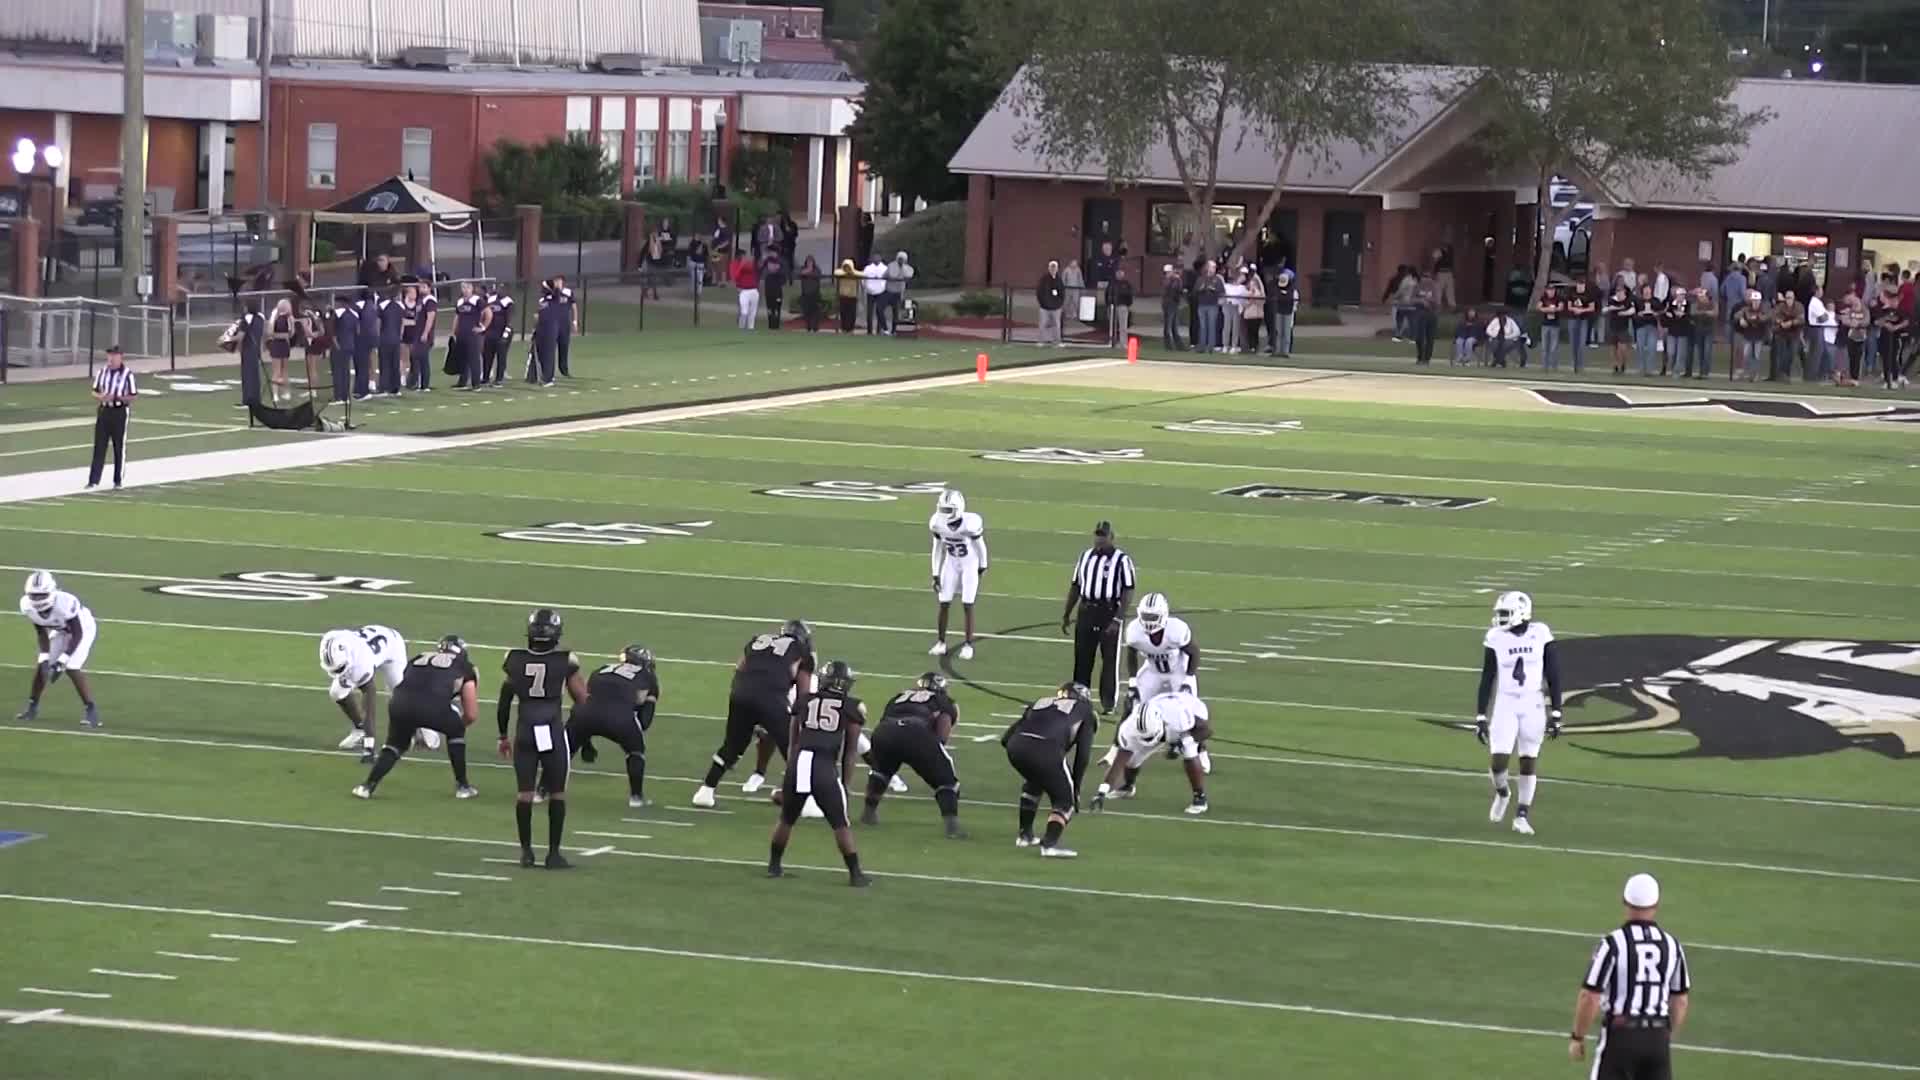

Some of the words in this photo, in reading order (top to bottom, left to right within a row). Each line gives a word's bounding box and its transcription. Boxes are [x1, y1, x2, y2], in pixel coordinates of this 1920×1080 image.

[945, 542, 968, 558] 23
[153, 571, 413, 600] 50
[524, 663, 546, 698] 7
[1512, 656, 1526, 687] 4
[804, 697, 842, 732] 15
[1635, 943, 1662, 982] R
